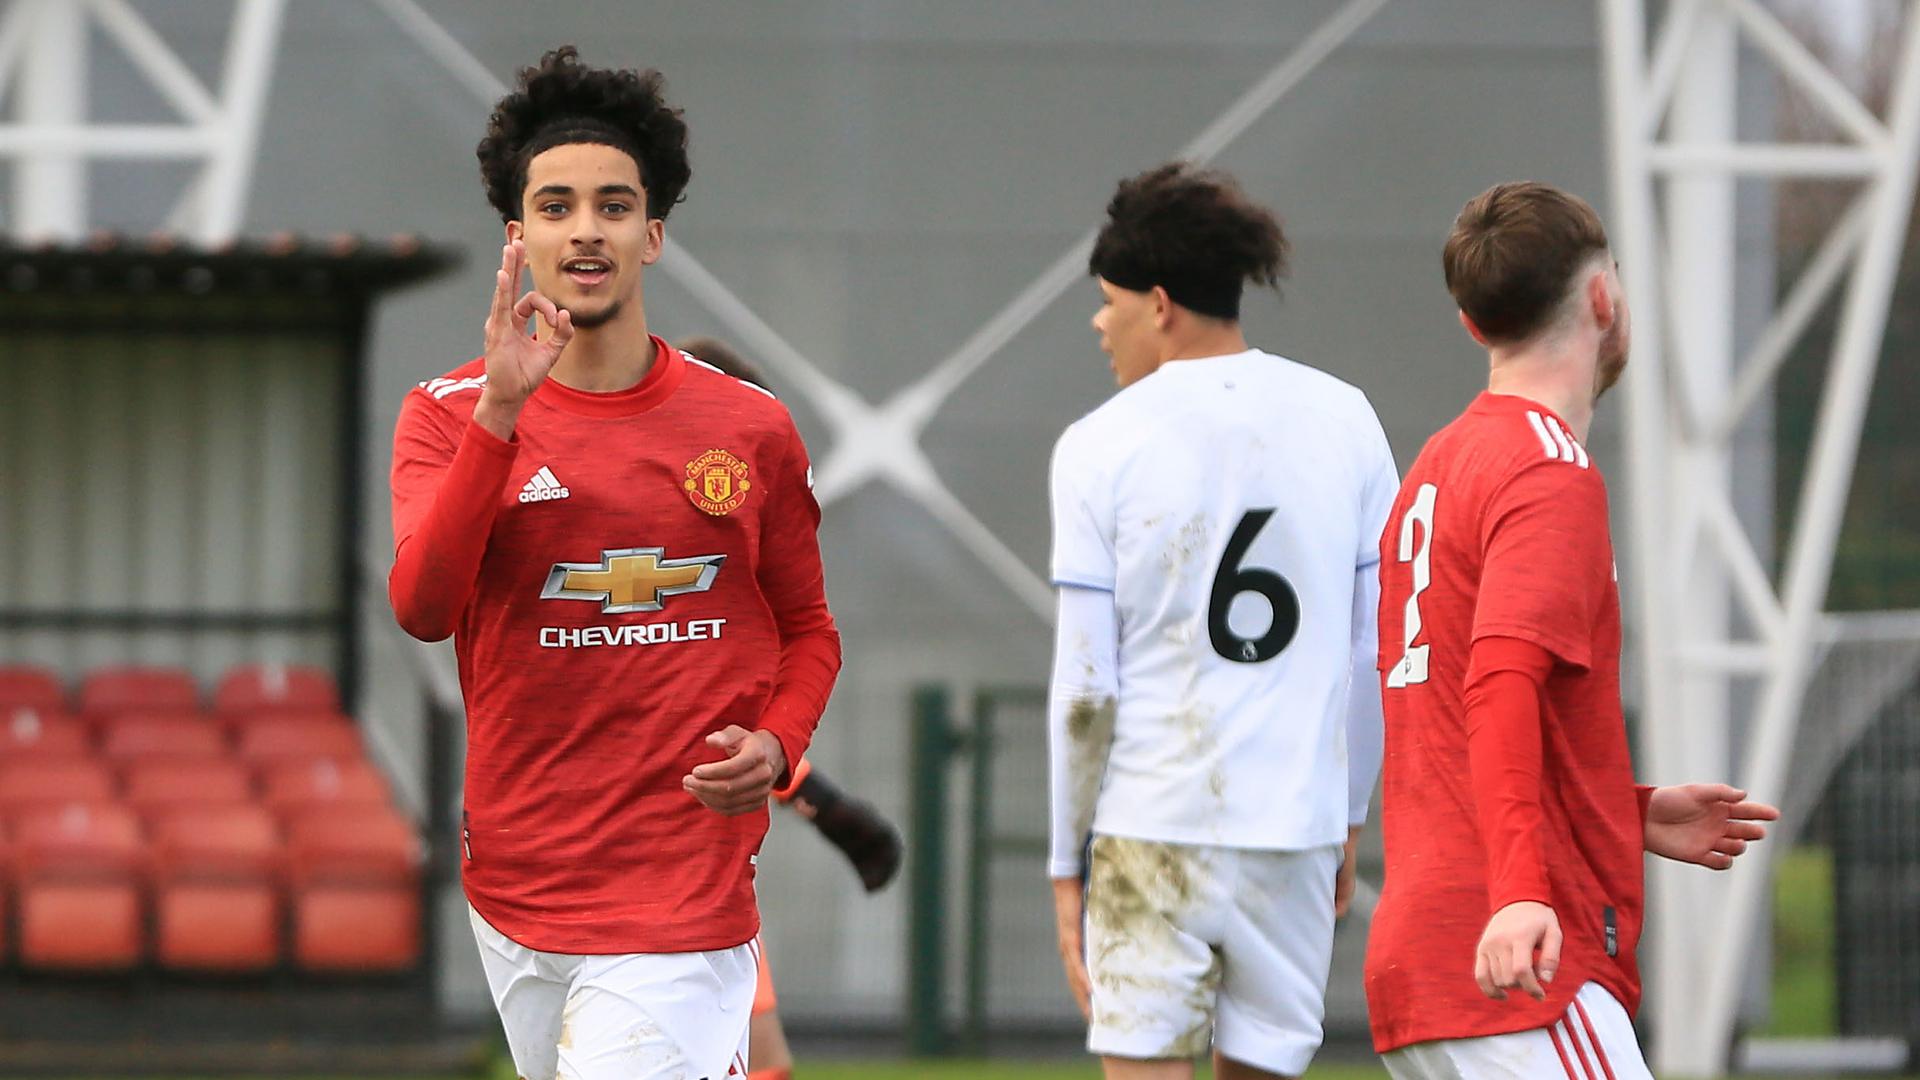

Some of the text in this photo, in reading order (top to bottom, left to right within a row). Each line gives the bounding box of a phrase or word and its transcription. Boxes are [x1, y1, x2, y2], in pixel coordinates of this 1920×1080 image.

[691, 454, 743, 475] MANCHESTER
[518, 486, 569, 502] adidas
[700, 500, 736, 511] UNITED
[1208, 508, 1301, 663] 6
[1387, 483, 1437, 688] 2
[539, 619, 726, 648] CHEVROLET
